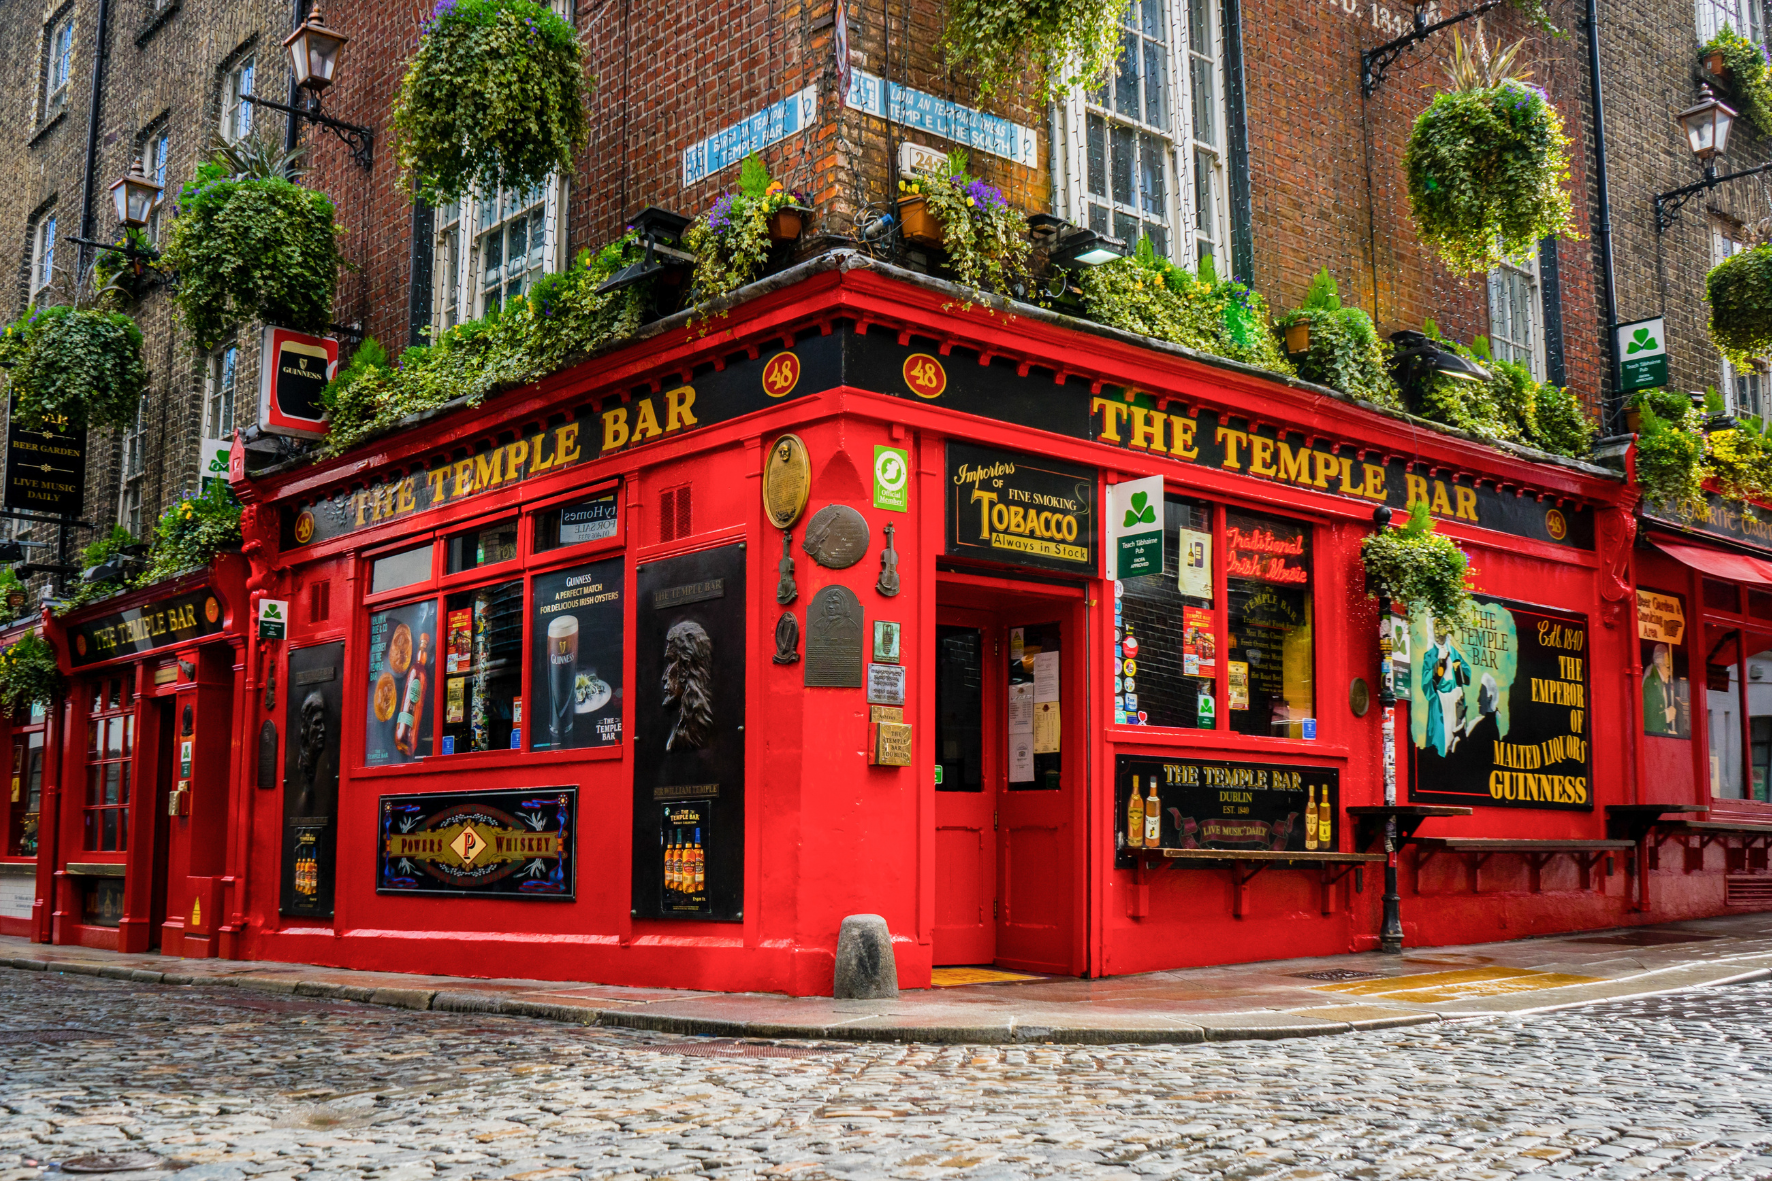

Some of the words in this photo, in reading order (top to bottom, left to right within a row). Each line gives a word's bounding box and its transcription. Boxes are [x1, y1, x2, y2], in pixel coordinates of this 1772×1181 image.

[803, 97, 812, 118] 2
[917, 97, 932, 111] AN
[890, 103, 934, 129] TEMPLE
[972, 131, 1010, 155] SOUTH
[721, 135, 758, 163] TEMPLE
[1024, 141, 1033, 157] 2
[282, 366, 322, 381] GUINNESS
[768, 359, 793, 392] 48
[909, 359, 937, 388] 48
[12, 440, 39, 452] BEER
[40, 445, 81, 458] GARDEN
[354, 475, 417, 528] THE
[428, 422, 581, 506] TEMPLE
[602, 385, 699, 456] BAR
[1093, 396, 1199, 462] THE
[1215, 425, 1389, 501] TEMPLE
[1405, 472, 1479, 525] BAR
[13, 477, 39, 488] LIVE
[40, 481, 77, 493] MUSIC
[953, 461, 1016, 491] Importers
[992, 478, 1004, 489] OF
[27, 490, 61, 502] DAILY
[1008, 488, 1032, 504] FINE
[1032, 493, 1078, 512] SMOKING
[971, 488, 1078, 543] TOBACCO
[298, 518, 310, 539] 48
[993, 532, 1035, 554] Always
[1040, 541, 1050, 554] in
[1054, 545, 1087, 561] Stock
[1134, 547, 1145, 555] Pub
[1226, 527, 1304, 555] Traditional
[1226, 550, 1261, 576] Irish
[1265, 558, 1307, 583] Music
[560, 588, 583, 600] PERFECT
[583, 582, 603, 595] MATCH
[566, 573, 592, 588] GUINNESS
[655, 590, 669, 602] THE
[672, 584, 703, 599] TEMPLE
[704, 580, 722, 592] BAR
[540, 605, 552, 615] FOR
[551, 599, 579, 613] DELICIOUS
[580, 595, 594, 607] IRISH
[594, 591, 619, 604] OYSTERS
[1242, 593, 1278, 614] TEMPLE
[1280, 598, 1297, 622] BAR
[94, 625, 118, 651] THE
[117, 612, 167, 645] TEMPLE
[167, 603, 198, 632] BAR
[1471, 609, 1497, 631] THE
[1460, 626, 1509, 652] TEMPLE
[1564, 628, 1583, 652] 1840
[551, 653, 575, 665] GUINNESS
[1472, 647, 1499, 670] BAR
[1558, 655, 1583, 682] THE
[1531, 677, 1585, 708] EMPEROR
[596, 723, 622, 734] TEMPLE
[1570, 709, 1584, 734] OF
[602, 732, 616, 741] BAR
[1493, 739, 1541, 770] MALTED
[1541, 734, 1587, 767] LIQUORS
[1164, 764, 1200, 786] THE
[1203, 766, 1268, 791] TEMPLE
[1272, 770, 1303, 792] BAR
[1488, 769, 1587, 804] GUINNESS
[1219, 791, 1253, 803] DUBLIN
[1222, 805, 1236, 815] EST.
[1237, 805, 1250, 815] 1840
[1203, 827, 1221, 836] LIVE
[1222, 826, 1244, 836] MUSIC
[1244, 826, 1267, 837] DAILY
[401, 838, 443, 853] POWERS
[463, 832, 476, 860] P
[495, 836, 551, 853] WHISKEY
